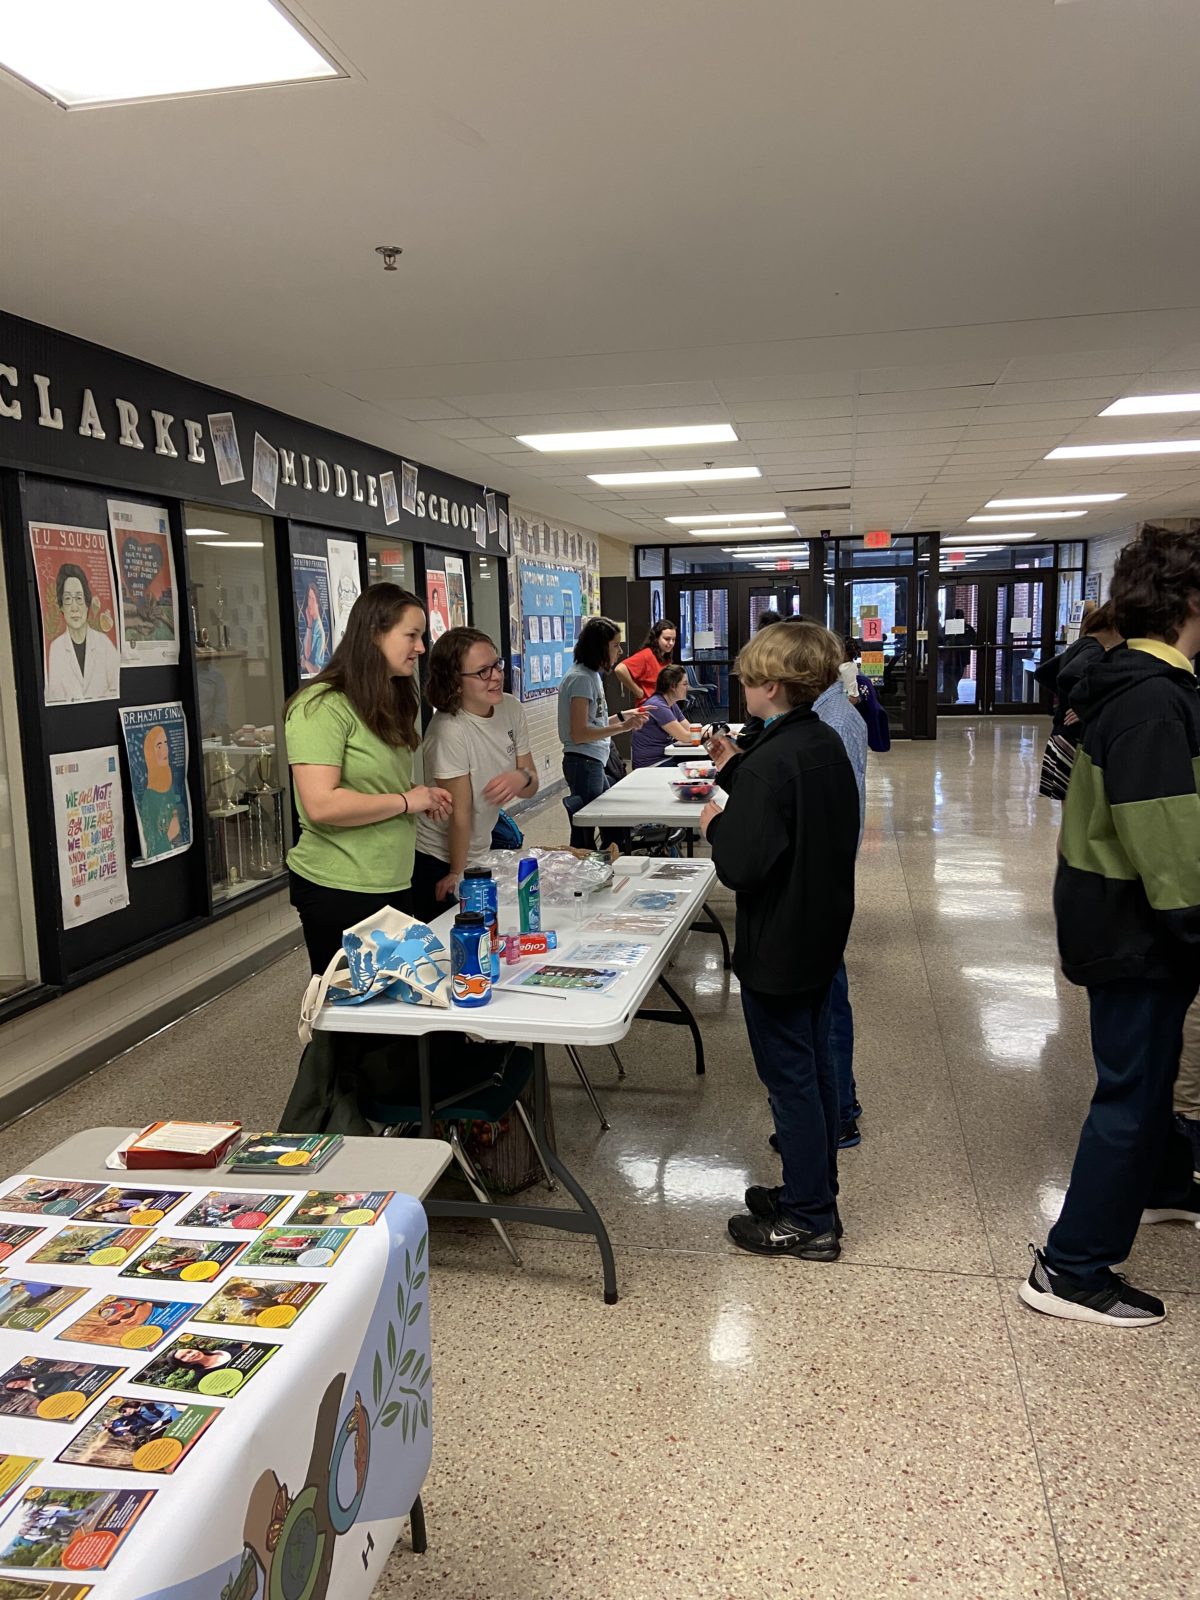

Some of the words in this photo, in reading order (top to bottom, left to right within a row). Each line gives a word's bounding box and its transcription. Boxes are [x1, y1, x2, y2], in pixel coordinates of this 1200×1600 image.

[0, 363, 205, 464] CLARKE
[279, 447, 377, 507] MIDDLE
[417, 490, 478, 532] SCHOOL
[32, 528, 50, 545] TU
[59, 531, 105, 550] YOUYOU
[868, 621, 878, 637] B
[66, 791, 78, 808] WE
[68, 837, 80, 852] WE
[99, 861, 118, 879] LOVE
[520, 942, 546, 952] Colga
